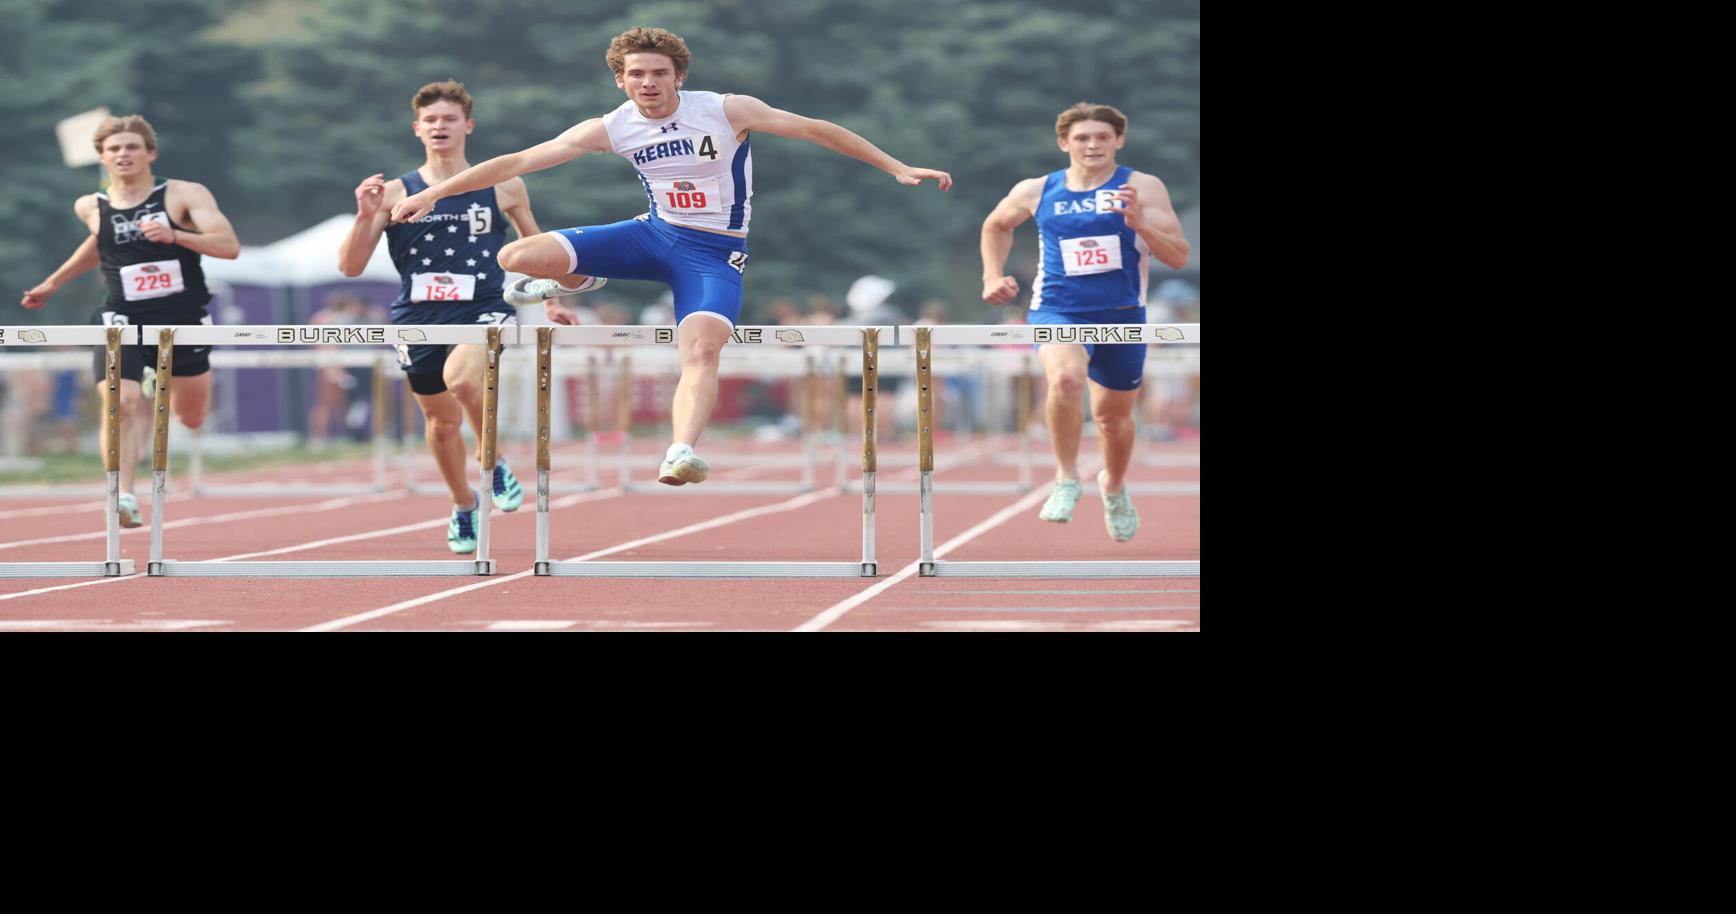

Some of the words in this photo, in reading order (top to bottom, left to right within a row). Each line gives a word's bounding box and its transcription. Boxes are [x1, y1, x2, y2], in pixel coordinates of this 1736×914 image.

[633, 139, 695, 165] KEARN
[699, 135, 717, 160] 4
[666, 192, 706, 208] 109
[1054, 198, 1096, 215] EAS
[474, 210, 487, 232] 5
[1074, 248, 1108, 266] 125
[134, 273, 172, 292] 229
[425, 285, 460, 301] 154
[277, 328, 385, 343] BURKE
[1034, 327, 1142, 342] BURKE
